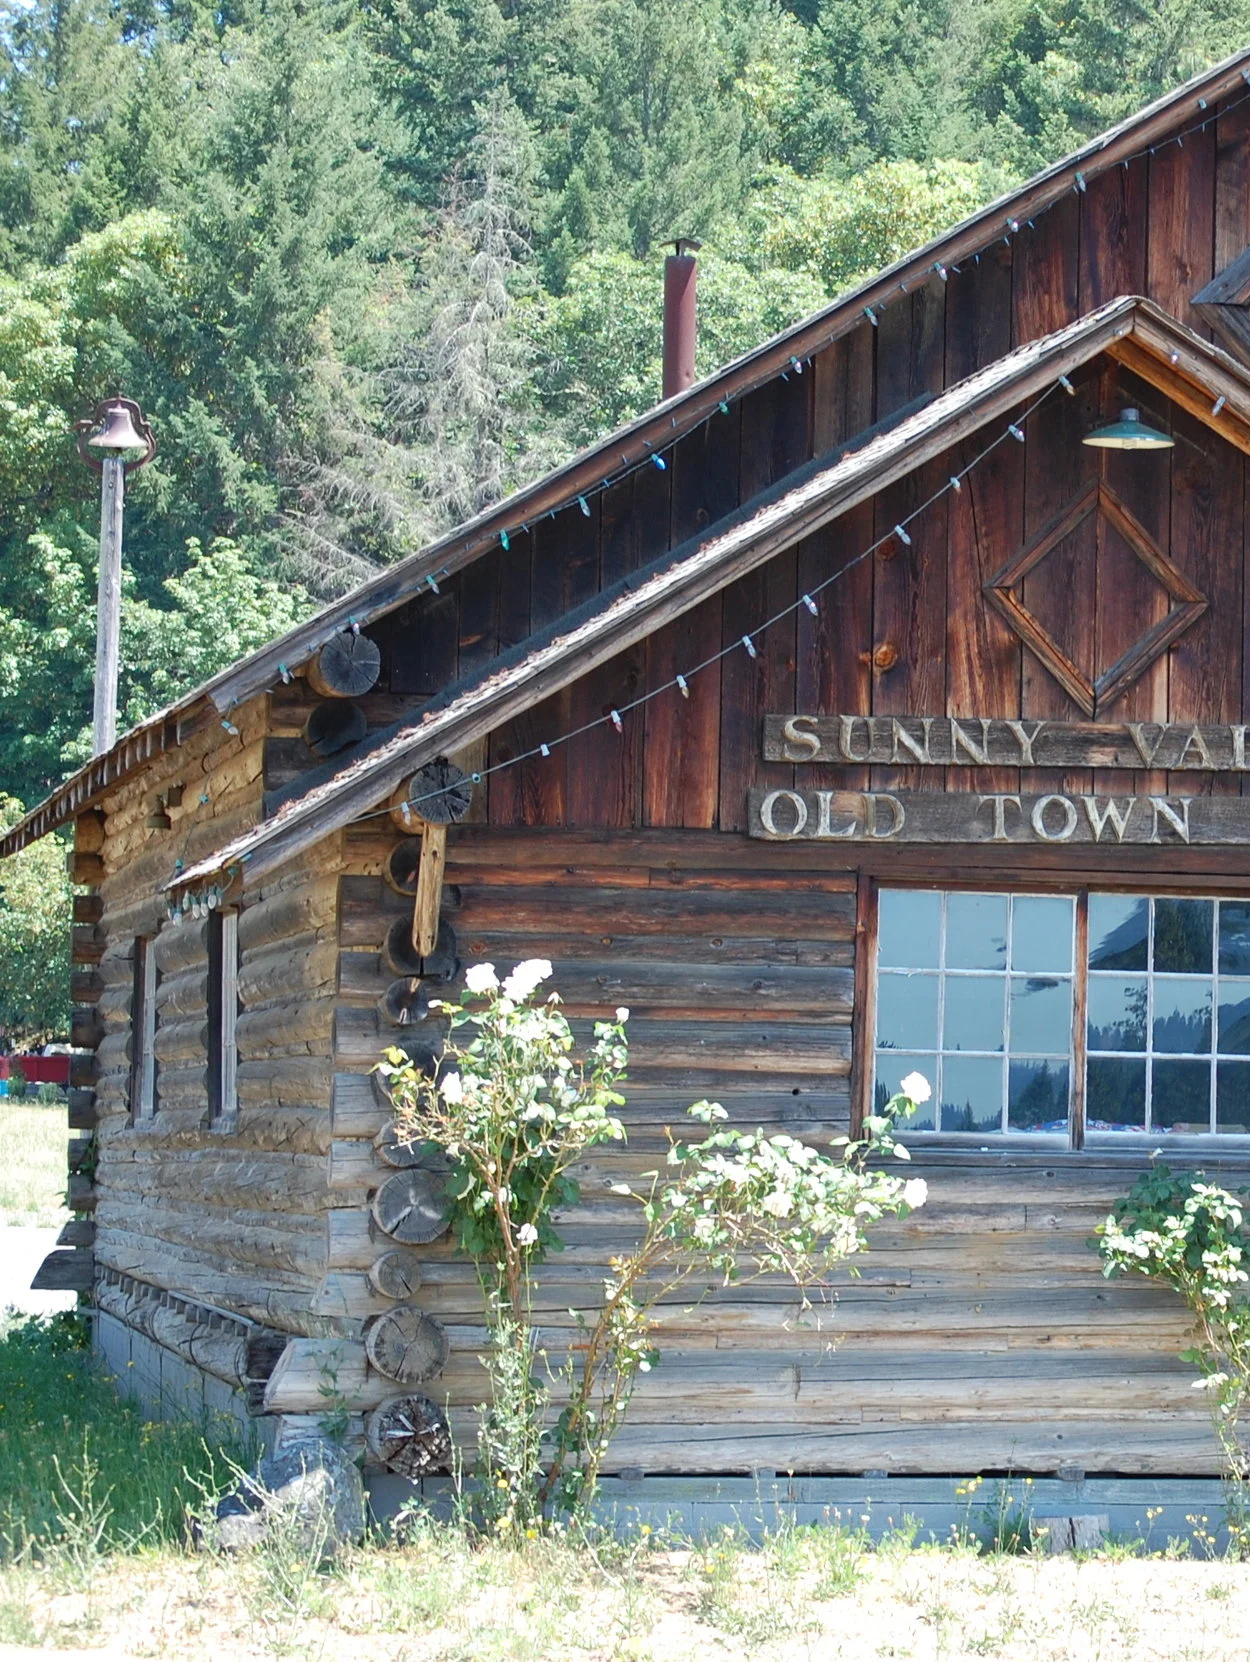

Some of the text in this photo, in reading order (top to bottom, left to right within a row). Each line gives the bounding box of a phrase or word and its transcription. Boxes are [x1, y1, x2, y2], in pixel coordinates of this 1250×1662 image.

[783, 715, 1046, 765] SUNNY
[760, 791, 906, 838] OLD
[978, 795, 1190, 843] TOWN
